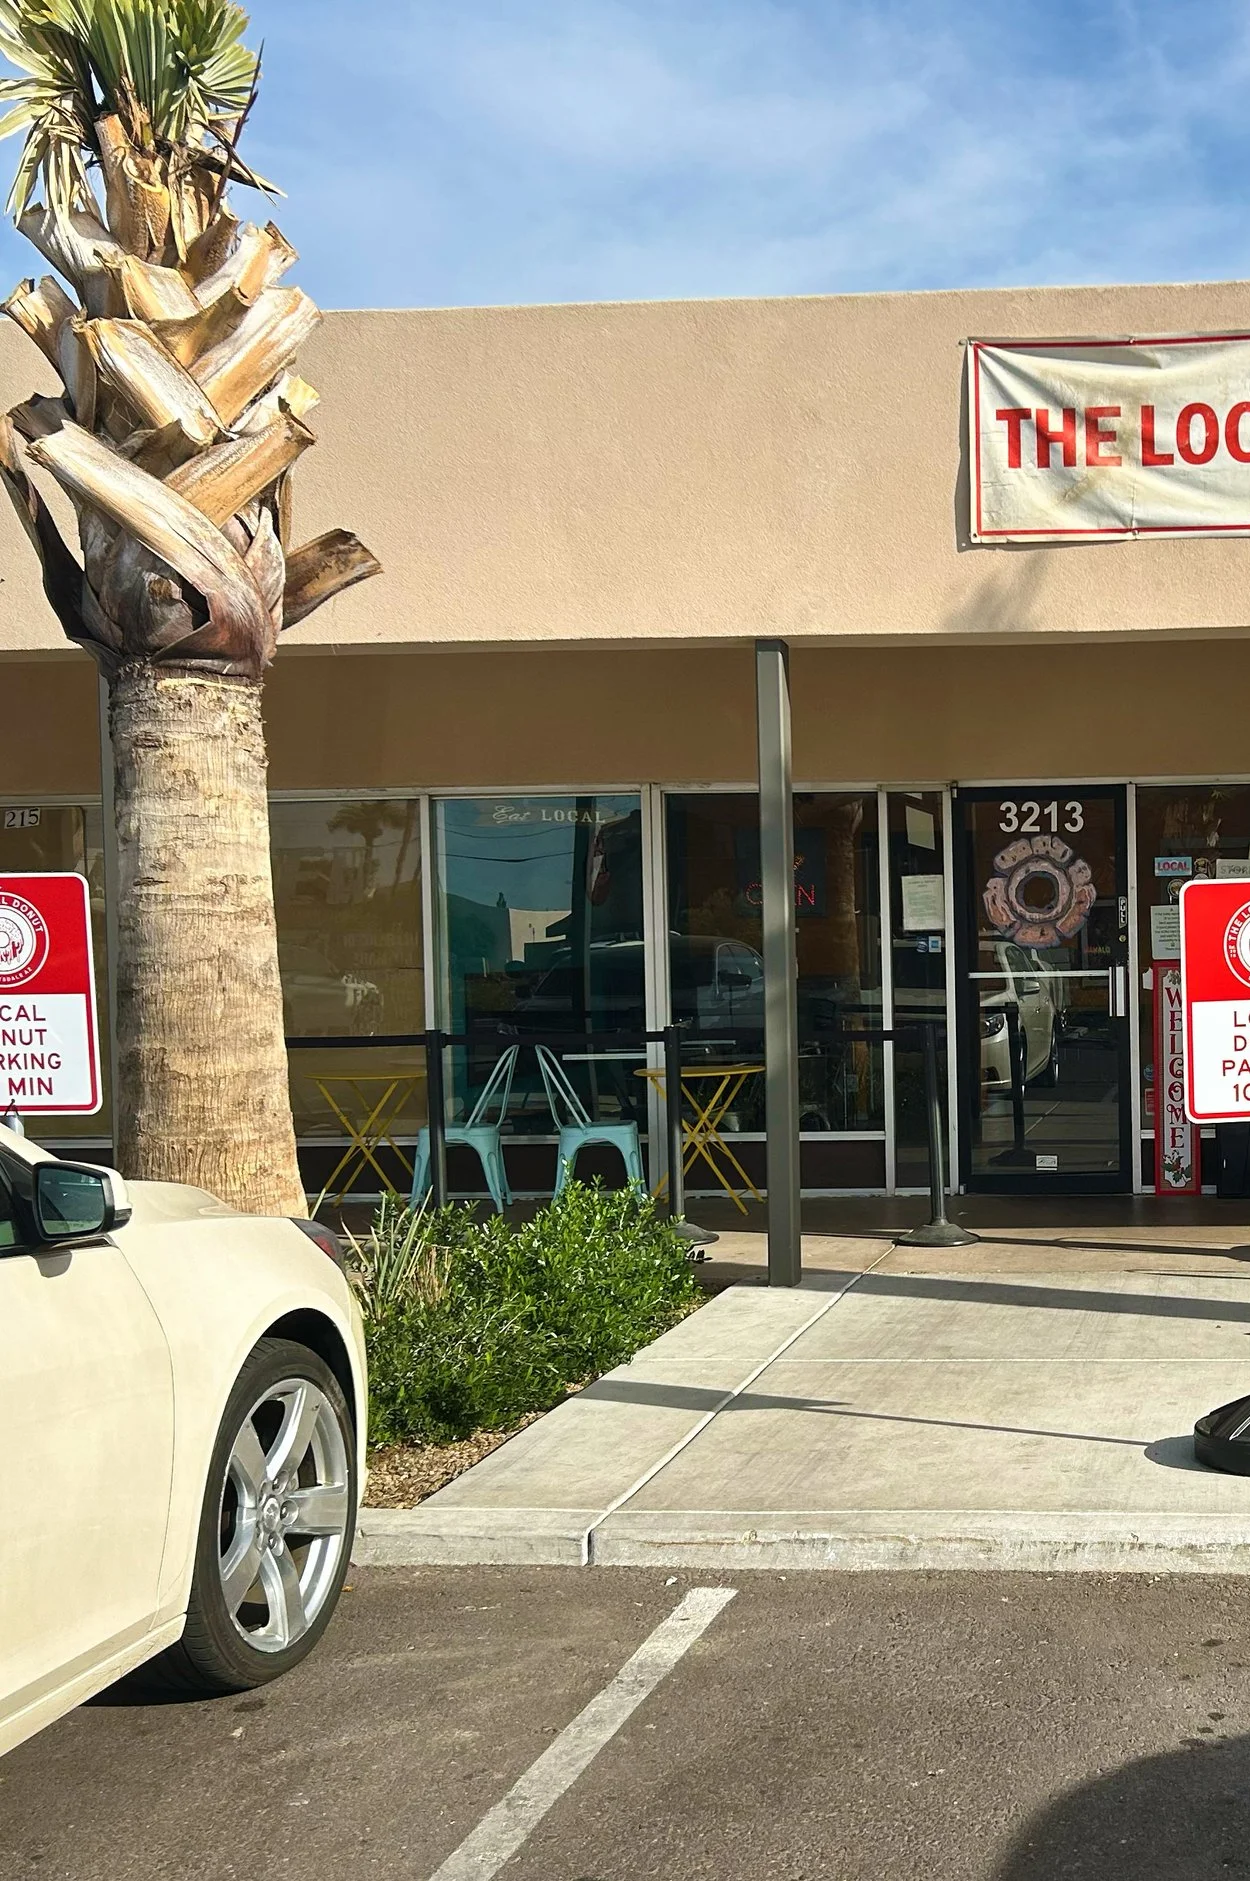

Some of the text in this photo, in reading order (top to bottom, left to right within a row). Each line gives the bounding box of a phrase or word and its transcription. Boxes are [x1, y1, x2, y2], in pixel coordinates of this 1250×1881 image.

[996, 406, 1122, 469] THE
[6, 808, 39, 828] 215
[492, 805, 606, 824] Eat LOCAL
[999, 801, 1084, 833] 3213
[1157, 861, 1190, 872] LOCAL
[12, 899, 44, 933] DONUT
[1228, 918, 1243, 941] THE
[2, 1029, 48, 1046] NUT
[1165, 987, 1187, 1149] WELCOME
[8, 1077, 54, 1096] MIN
